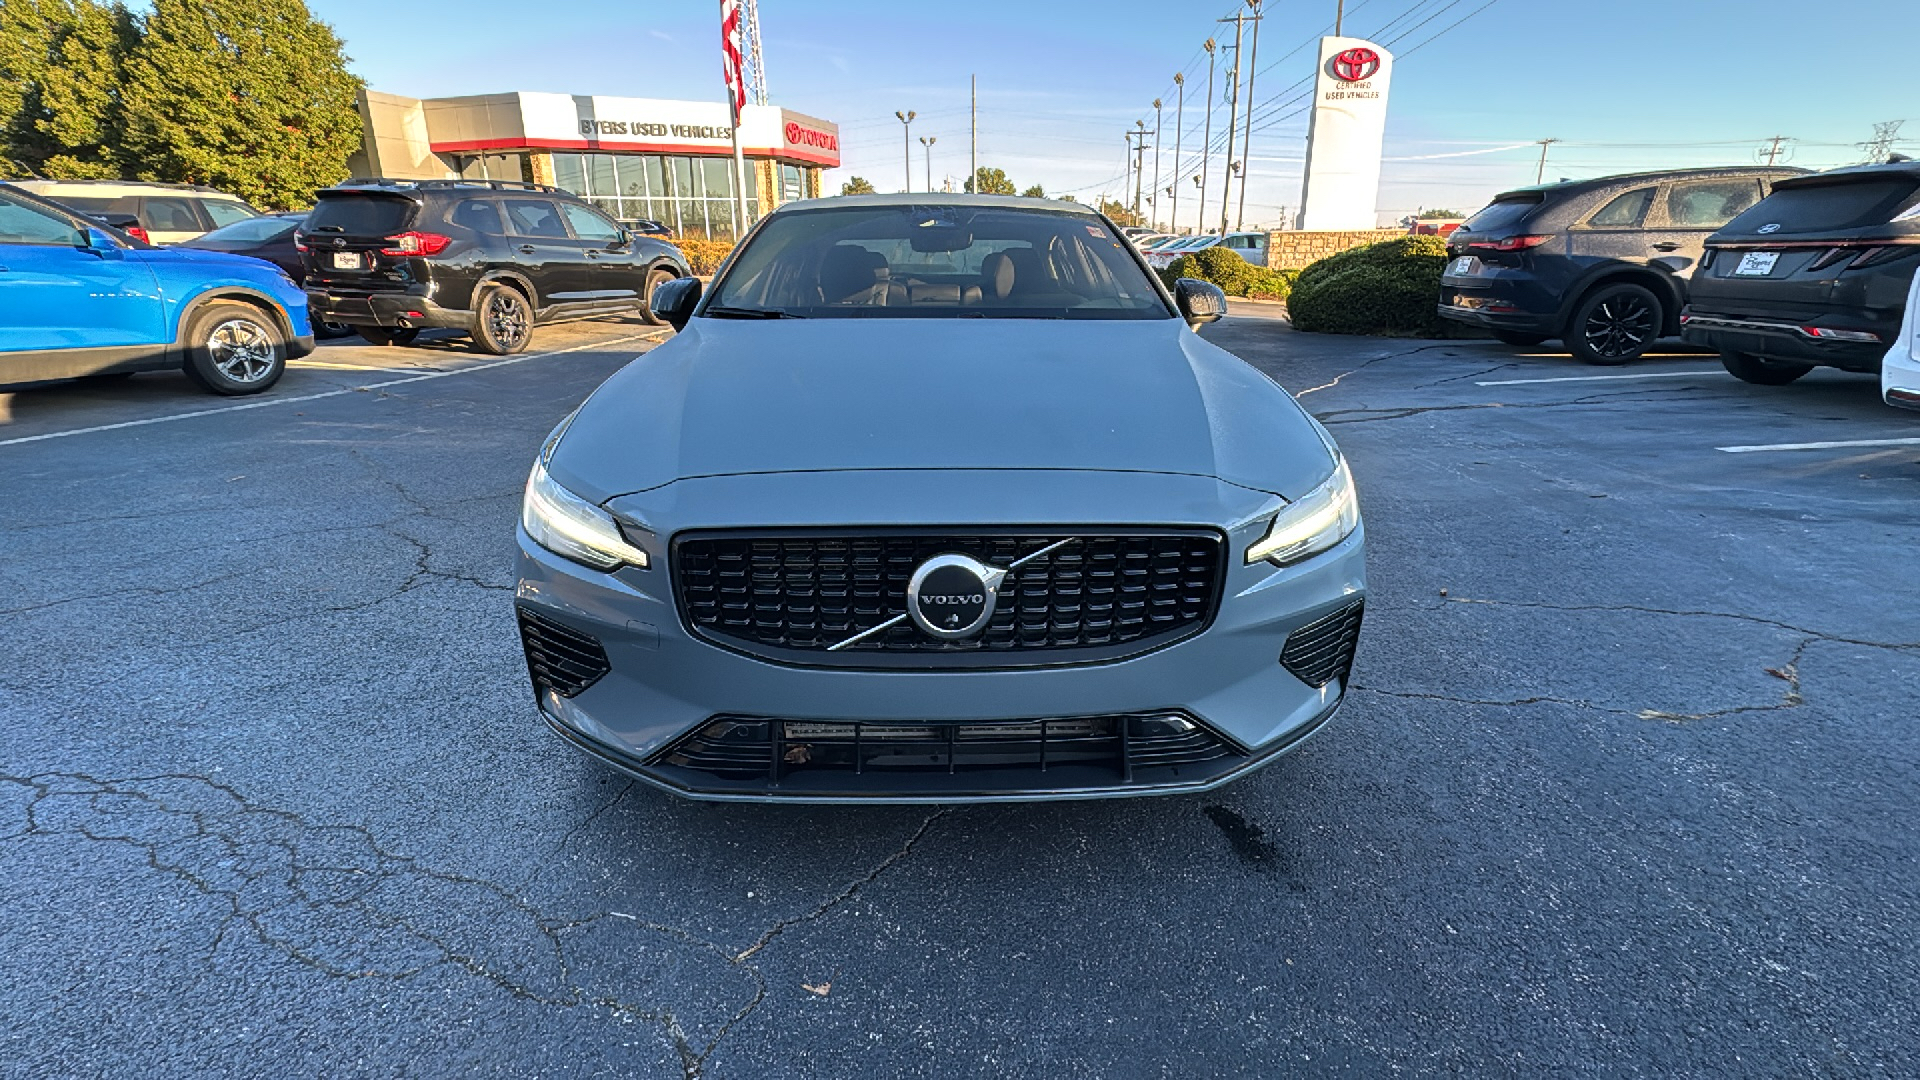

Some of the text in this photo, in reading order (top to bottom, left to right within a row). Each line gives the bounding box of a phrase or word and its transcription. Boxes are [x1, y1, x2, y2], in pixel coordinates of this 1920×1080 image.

[1336, 82, 1371, 90] CERTIFIED
[1326, 91, 1380, 100] USED VEHICLES
[581, 119, 732, 139] BYERS USED VEHICLES
[801, 128, 837, 151] TOYOTA
[921, 594, 983, 604] VOLVO
